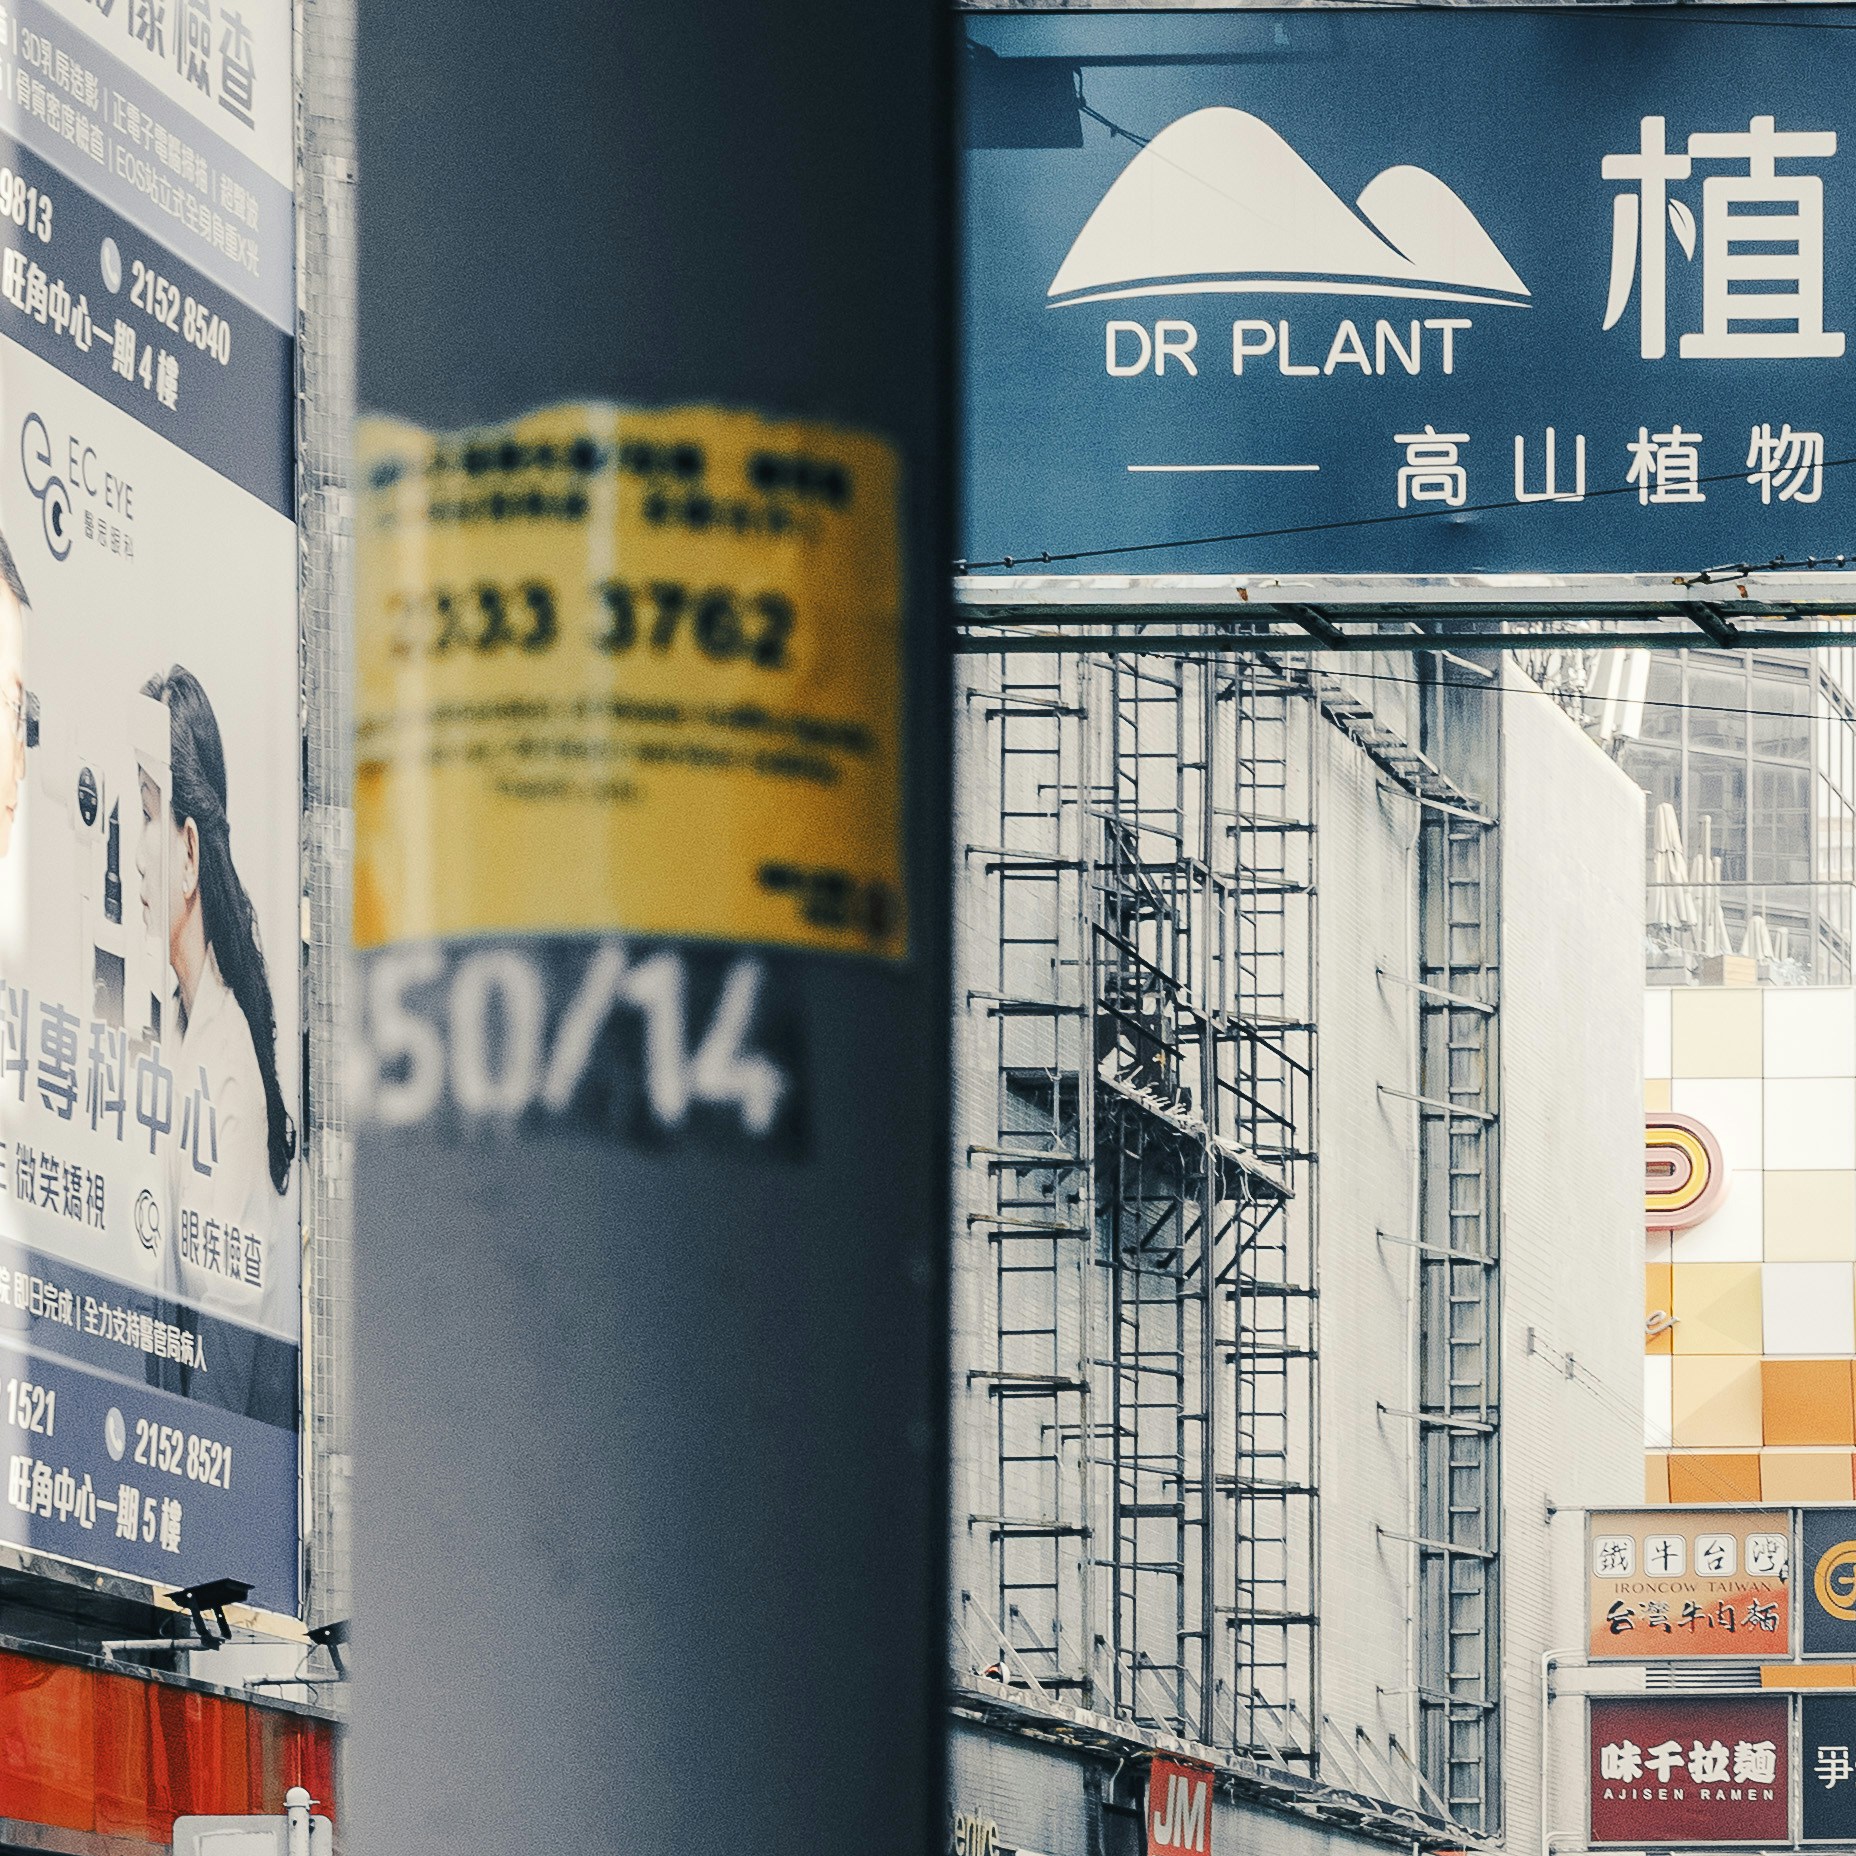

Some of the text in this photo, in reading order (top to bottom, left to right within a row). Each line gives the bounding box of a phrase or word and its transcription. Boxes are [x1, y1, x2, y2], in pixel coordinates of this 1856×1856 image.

[85, 0, 257, 131] 檢查
[16, 68, 104, 165] 骨質密度檢查
[2, 246, 136, 382] 旺角中心一期
[131, 260, 231, 366] 2152 8540
[1105, 318, 1473, 377] DR PLANT
[68, 435, 135, 522] EC EYE
[1394, 424, 1824, 508] 高山植物
[15, 1142, 106, 1231] 微笑矯視
[181, 1208, 263, 1289] 眼疾檢查
[13, 1269, 73, 1327] 即日完成
[84, 1295, 208, 1373] 全力支持醫管局病人
[134, 1418, 233, 1489] 2152 8521
[7, 1455, 184, 1555] 旺角中心一期 5 樓
[1615, 1580, 1772, 1594] IRONCOW TAIWAN
[1153, 1773, 1207, 1853] JM
[1603, 1788, 1775, 1801] AJISEN RAMEN
